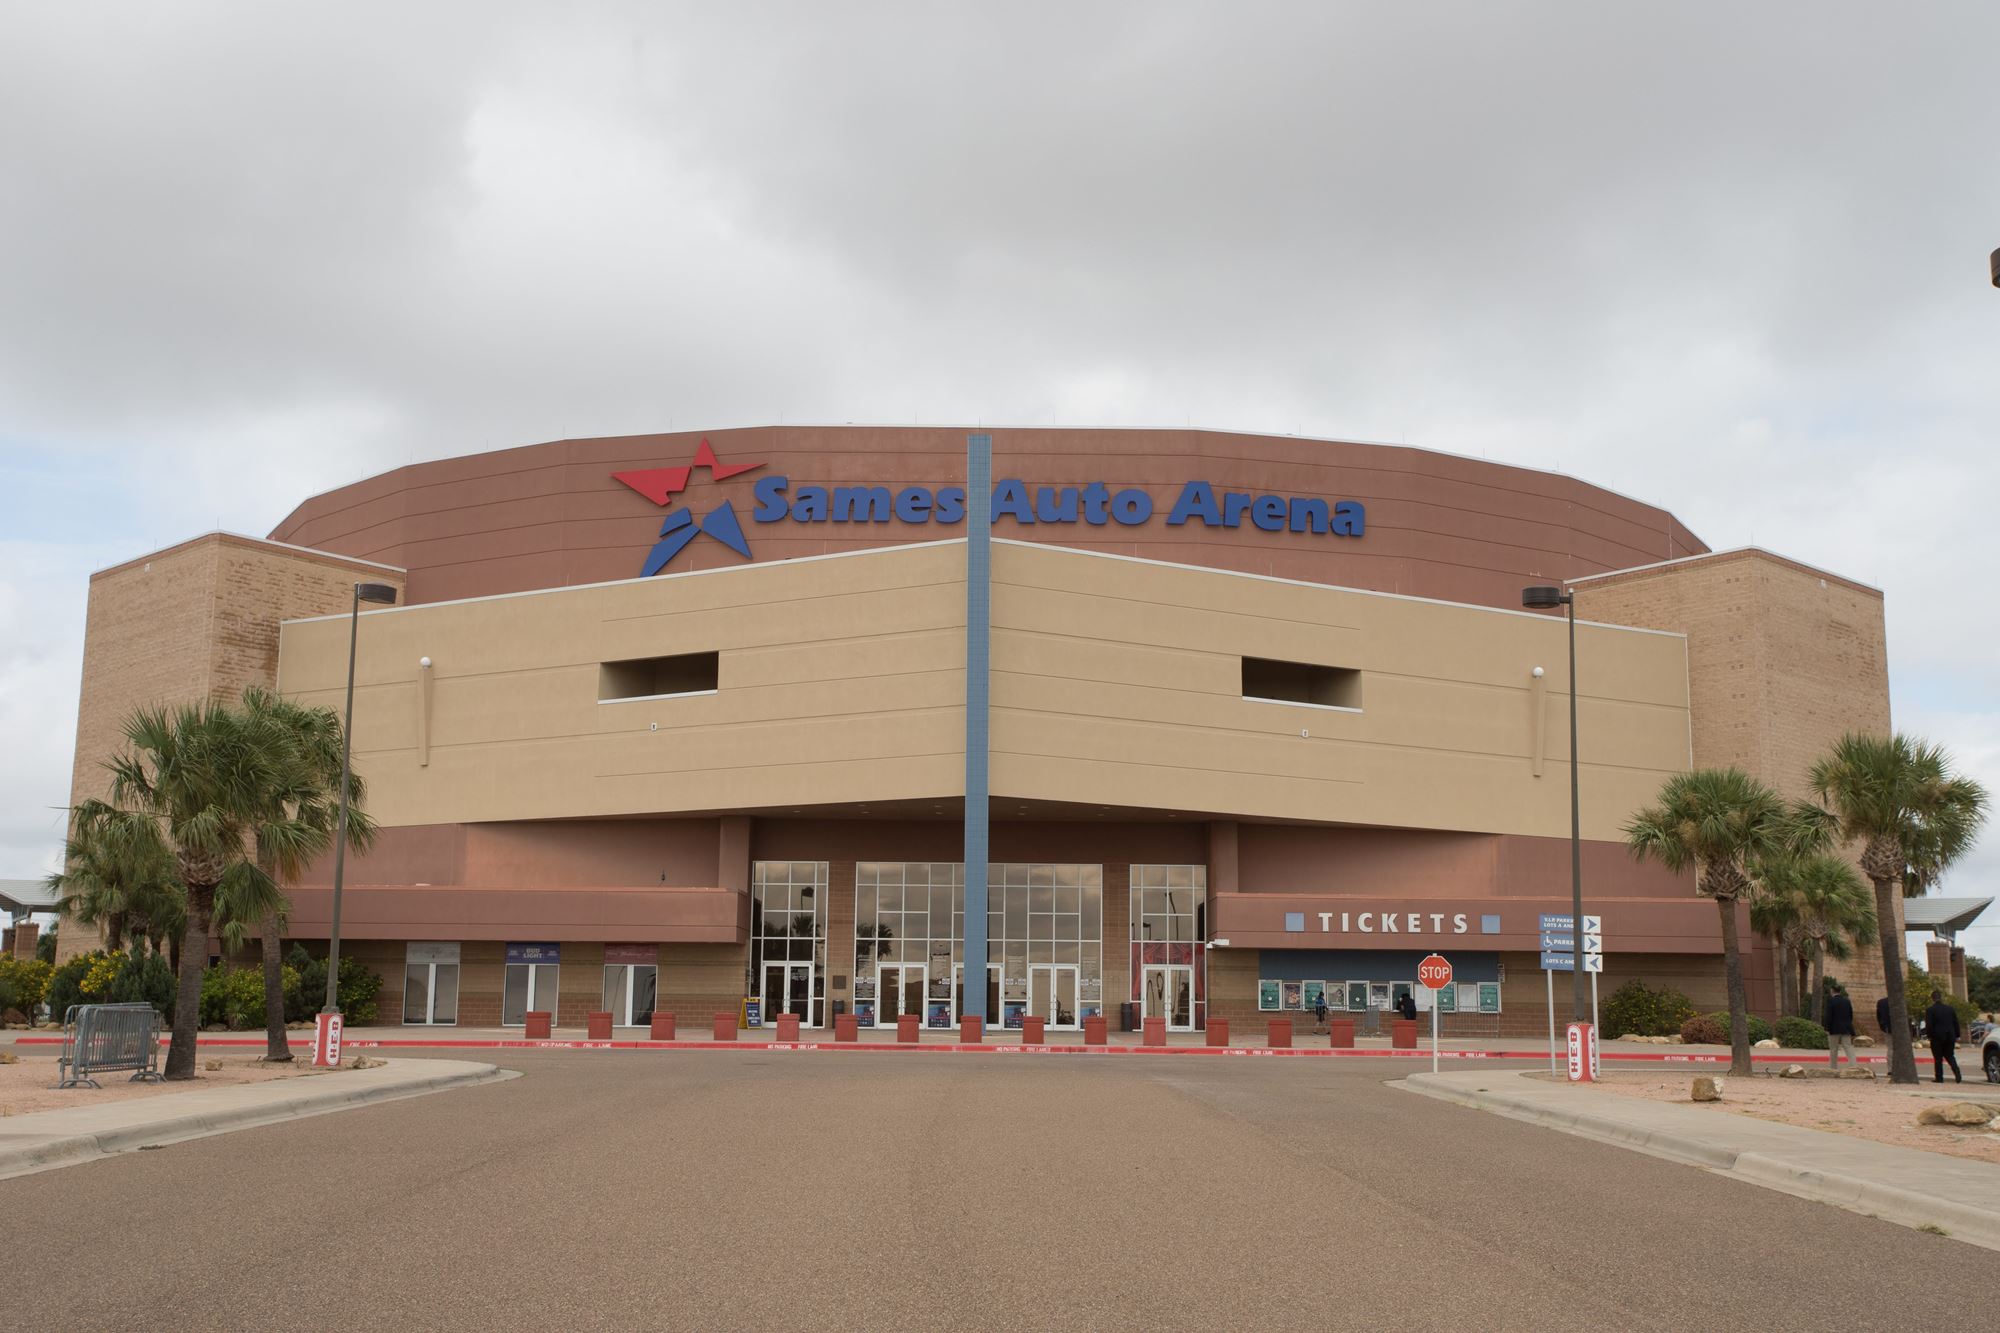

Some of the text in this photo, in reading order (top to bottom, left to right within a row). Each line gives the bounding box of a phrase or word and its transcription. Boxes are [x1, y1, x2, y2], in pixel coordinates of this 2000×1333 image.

[753, 476, 1366, 537] Sames Auto Arena
[1318, 912, 1468, 934] TICKETS
[1420, 966, 1450, 979] STOP
